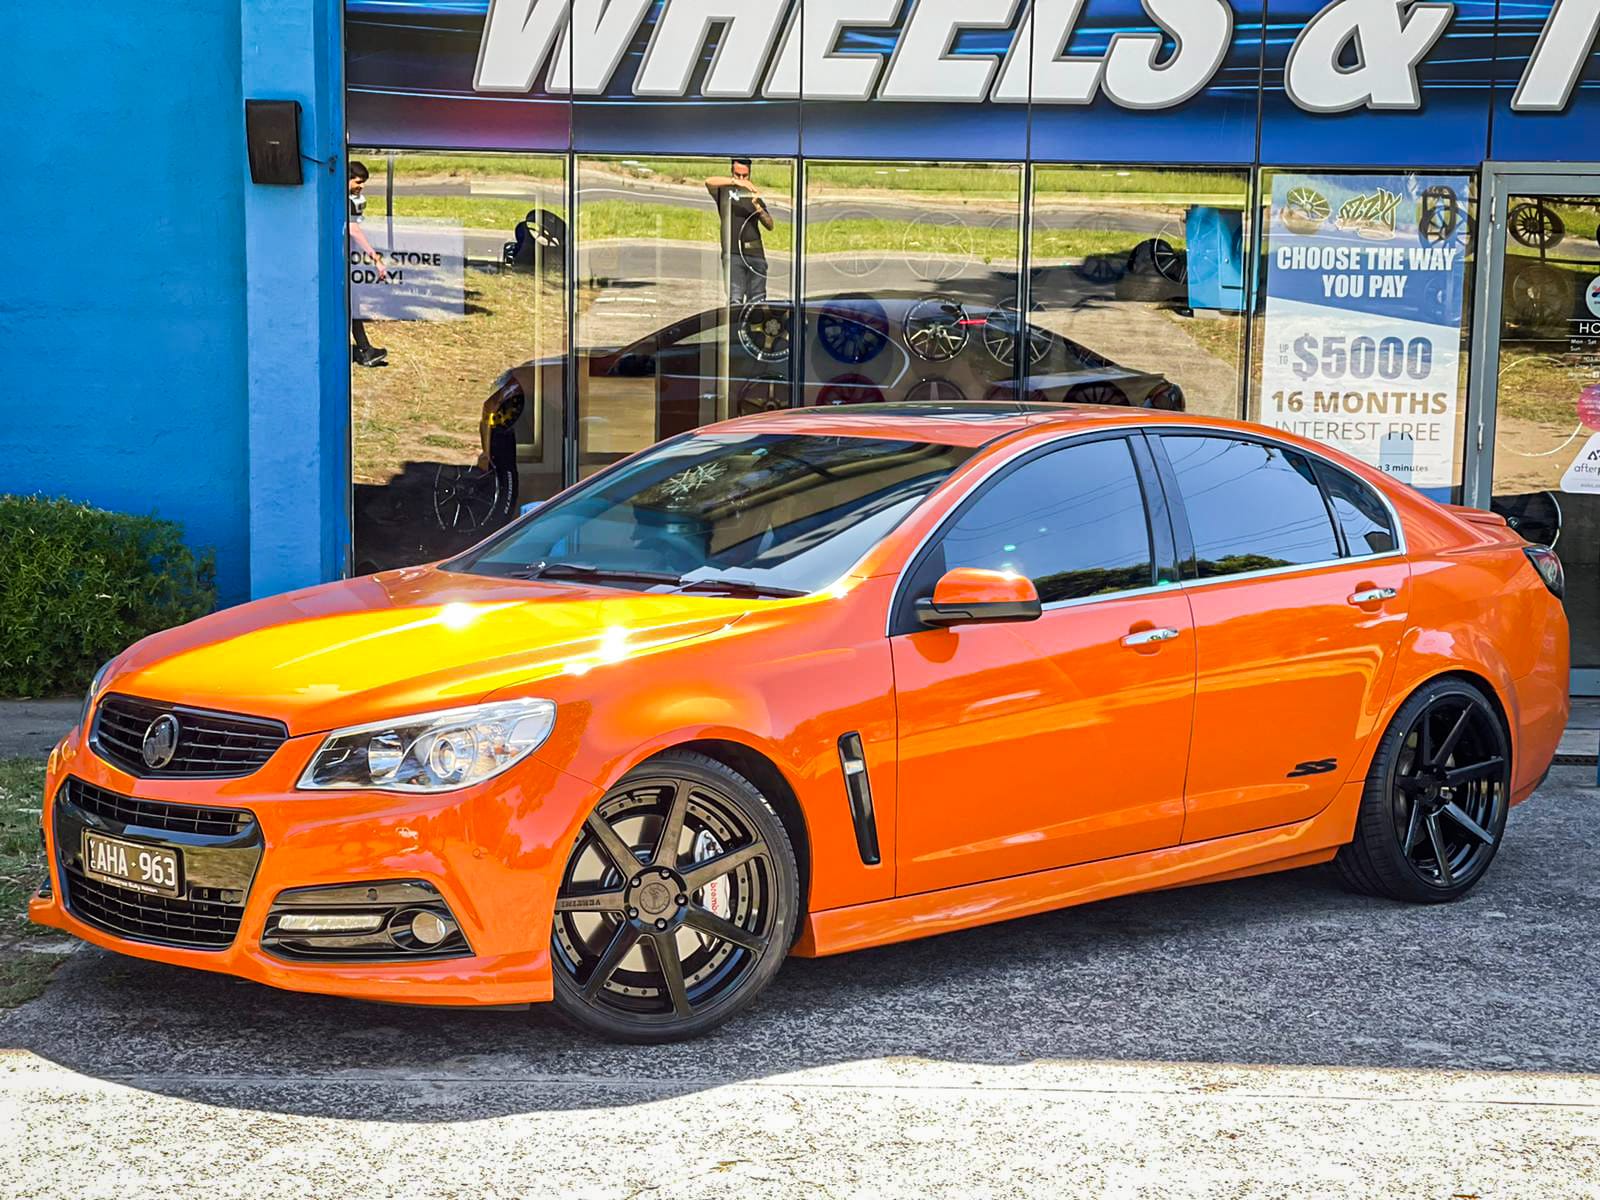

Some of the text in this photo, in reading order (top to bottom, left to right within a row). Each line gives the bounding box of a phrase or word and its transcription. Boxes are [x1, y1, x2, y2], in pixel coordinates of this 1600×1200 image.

[390, 252, 441, 266] STORE
[1277, 247, 1457, 271] CHOOSE THE WAY
[1323, 275, 1409, 298] YOU PAY
[1279, 343, 1290, 354] UP
[1293, 333, 1432, 381] $5000
[1279, 355, 1289, 365] TO
[1271, 391, 1448, 415] 16 MONTHS
[1388, 422, 1441, 441] FREE
[1384, 464, 1391, 472] 3
[1392, 464, 1429, 472] minutes
[1286, 757, 1338, 778] SS
[97, 842, 129, 877] AHA
[139, 852, 176, 887] 963
